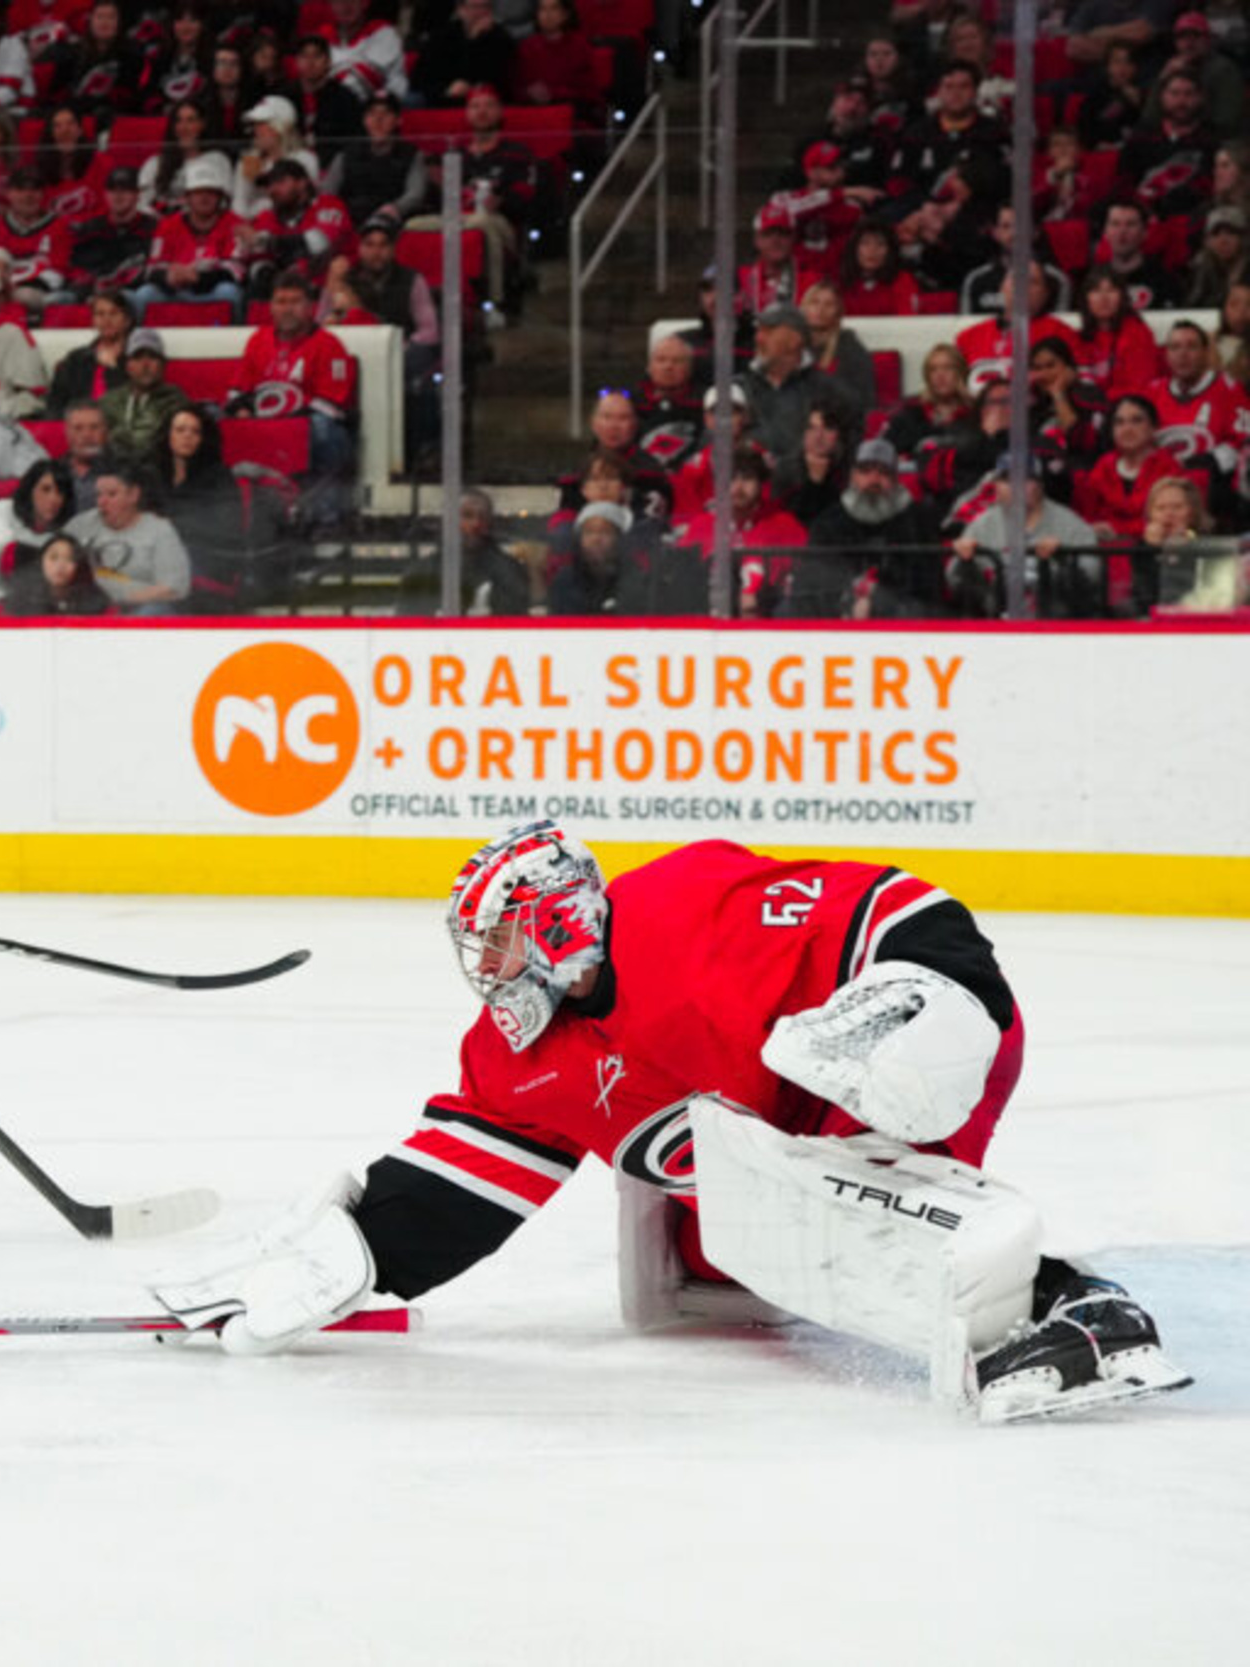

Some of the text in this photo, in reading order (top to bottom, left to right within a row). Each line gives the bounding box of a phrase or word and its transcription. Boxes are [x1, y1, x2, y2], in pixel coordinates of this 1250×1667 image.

[372, 654, 964, 711] ORAL SURGERY
[427, 727, 960, 786] ORTHODONTICS
[351, 794, 975, 824] OFFICIAL TEAM ORAL SURGEON & ORTHODONTIST
[761, 876, 823, 927] 52
[822, 1174, 963, 1232] TRUE
